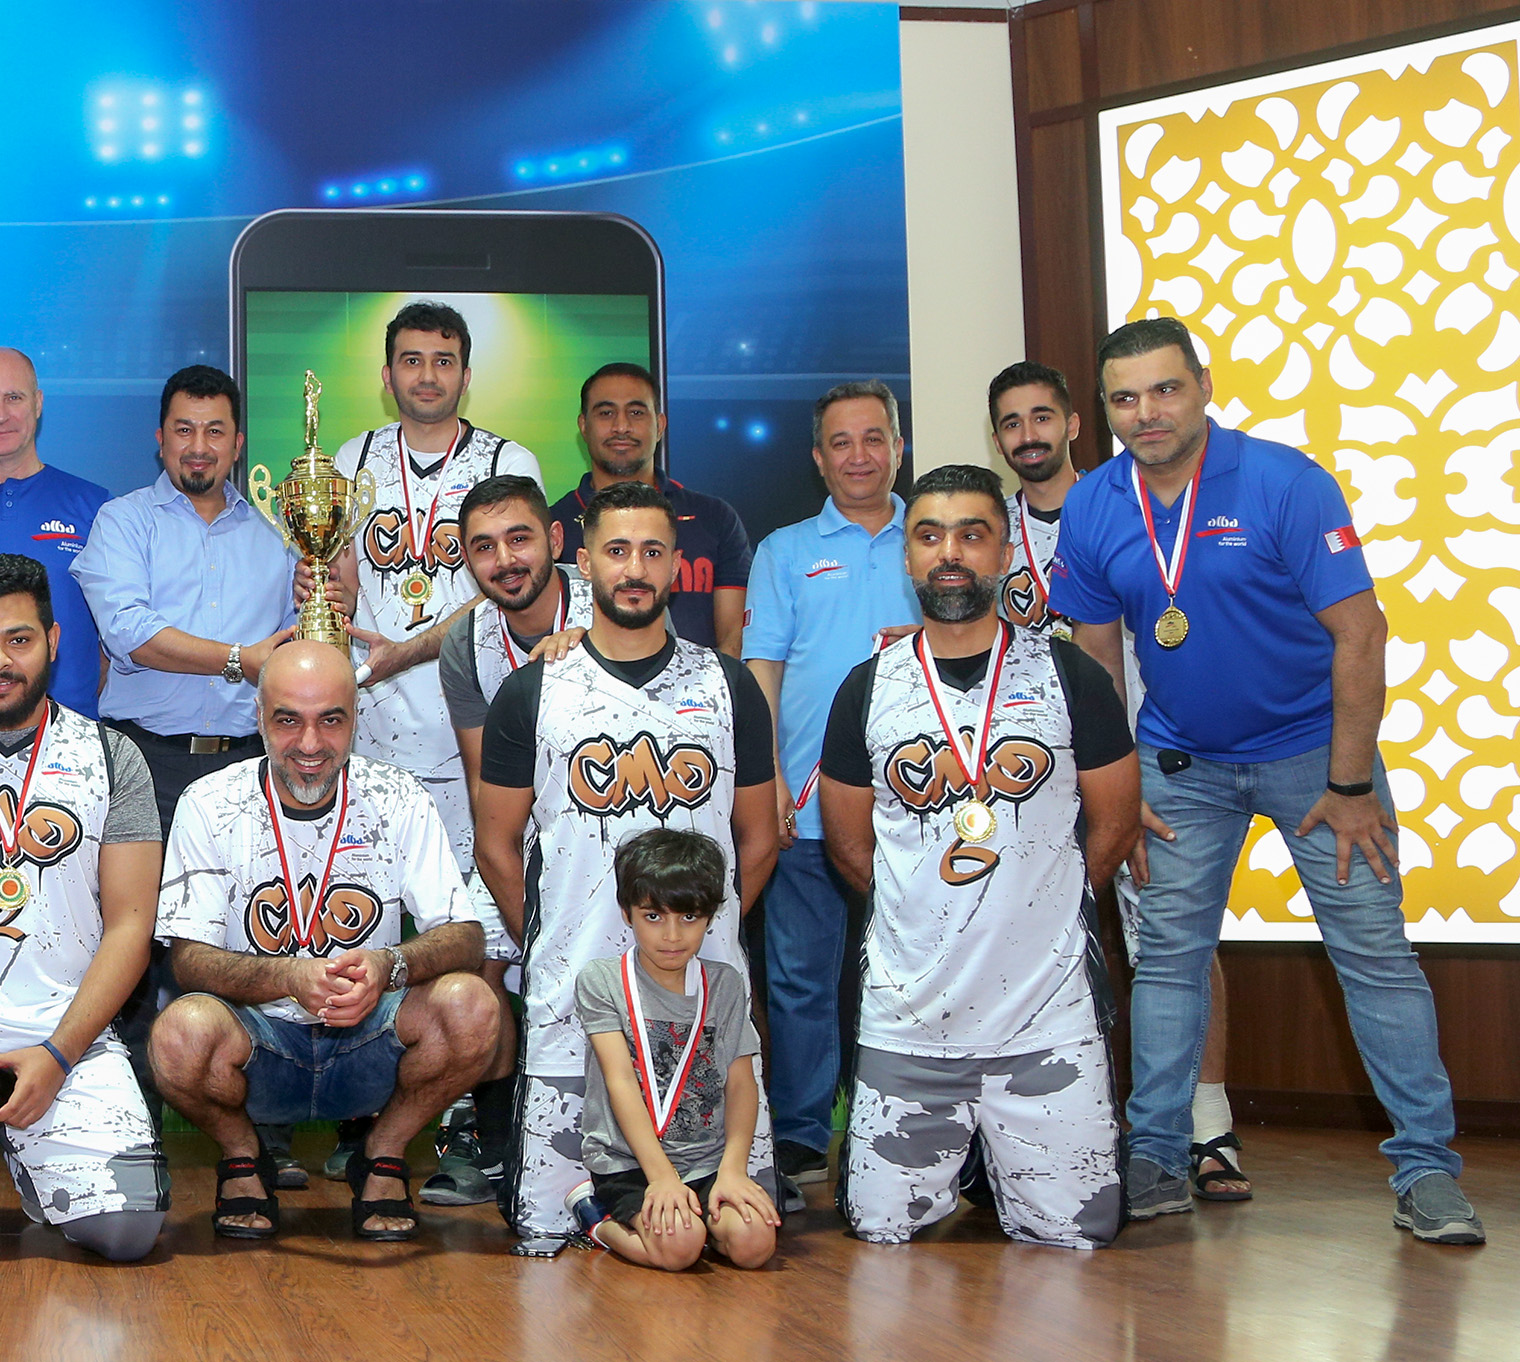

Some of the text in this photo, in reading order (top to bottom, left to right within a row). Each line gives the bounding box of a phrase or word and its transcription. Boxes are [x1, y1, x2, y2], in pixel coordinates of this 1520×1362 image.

[40, 519, 76, 534] alba
[567, 730, 718, 820] CMO
[939, 837, 1001, 887] 6
